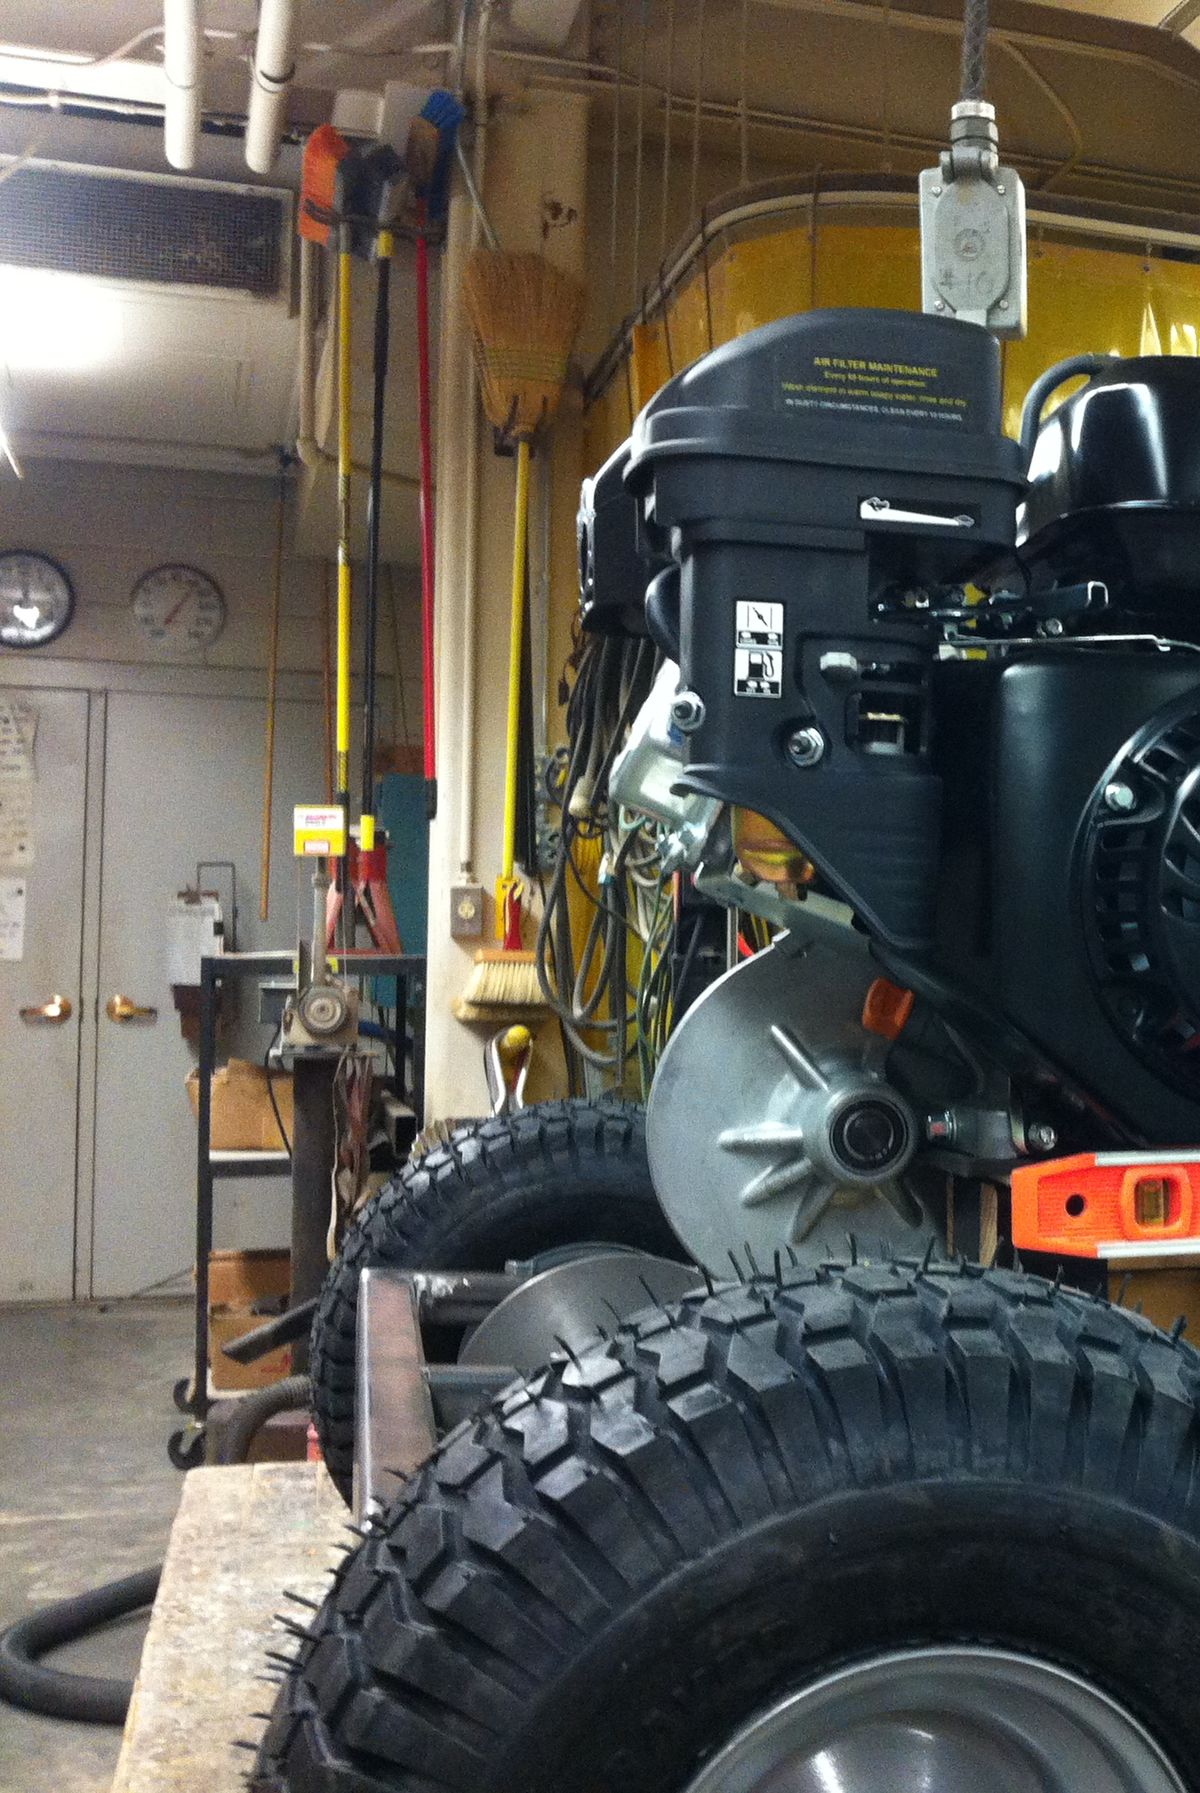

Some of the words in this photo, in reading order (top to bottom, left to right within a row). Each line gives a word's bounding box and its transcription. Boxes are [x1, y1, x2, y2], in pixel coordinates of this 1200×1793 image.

[814, 356, 831, 367] AIR
[833, 359, 866, 370] FILTER
[868, 361, 938, 378] MAINTENANCE
